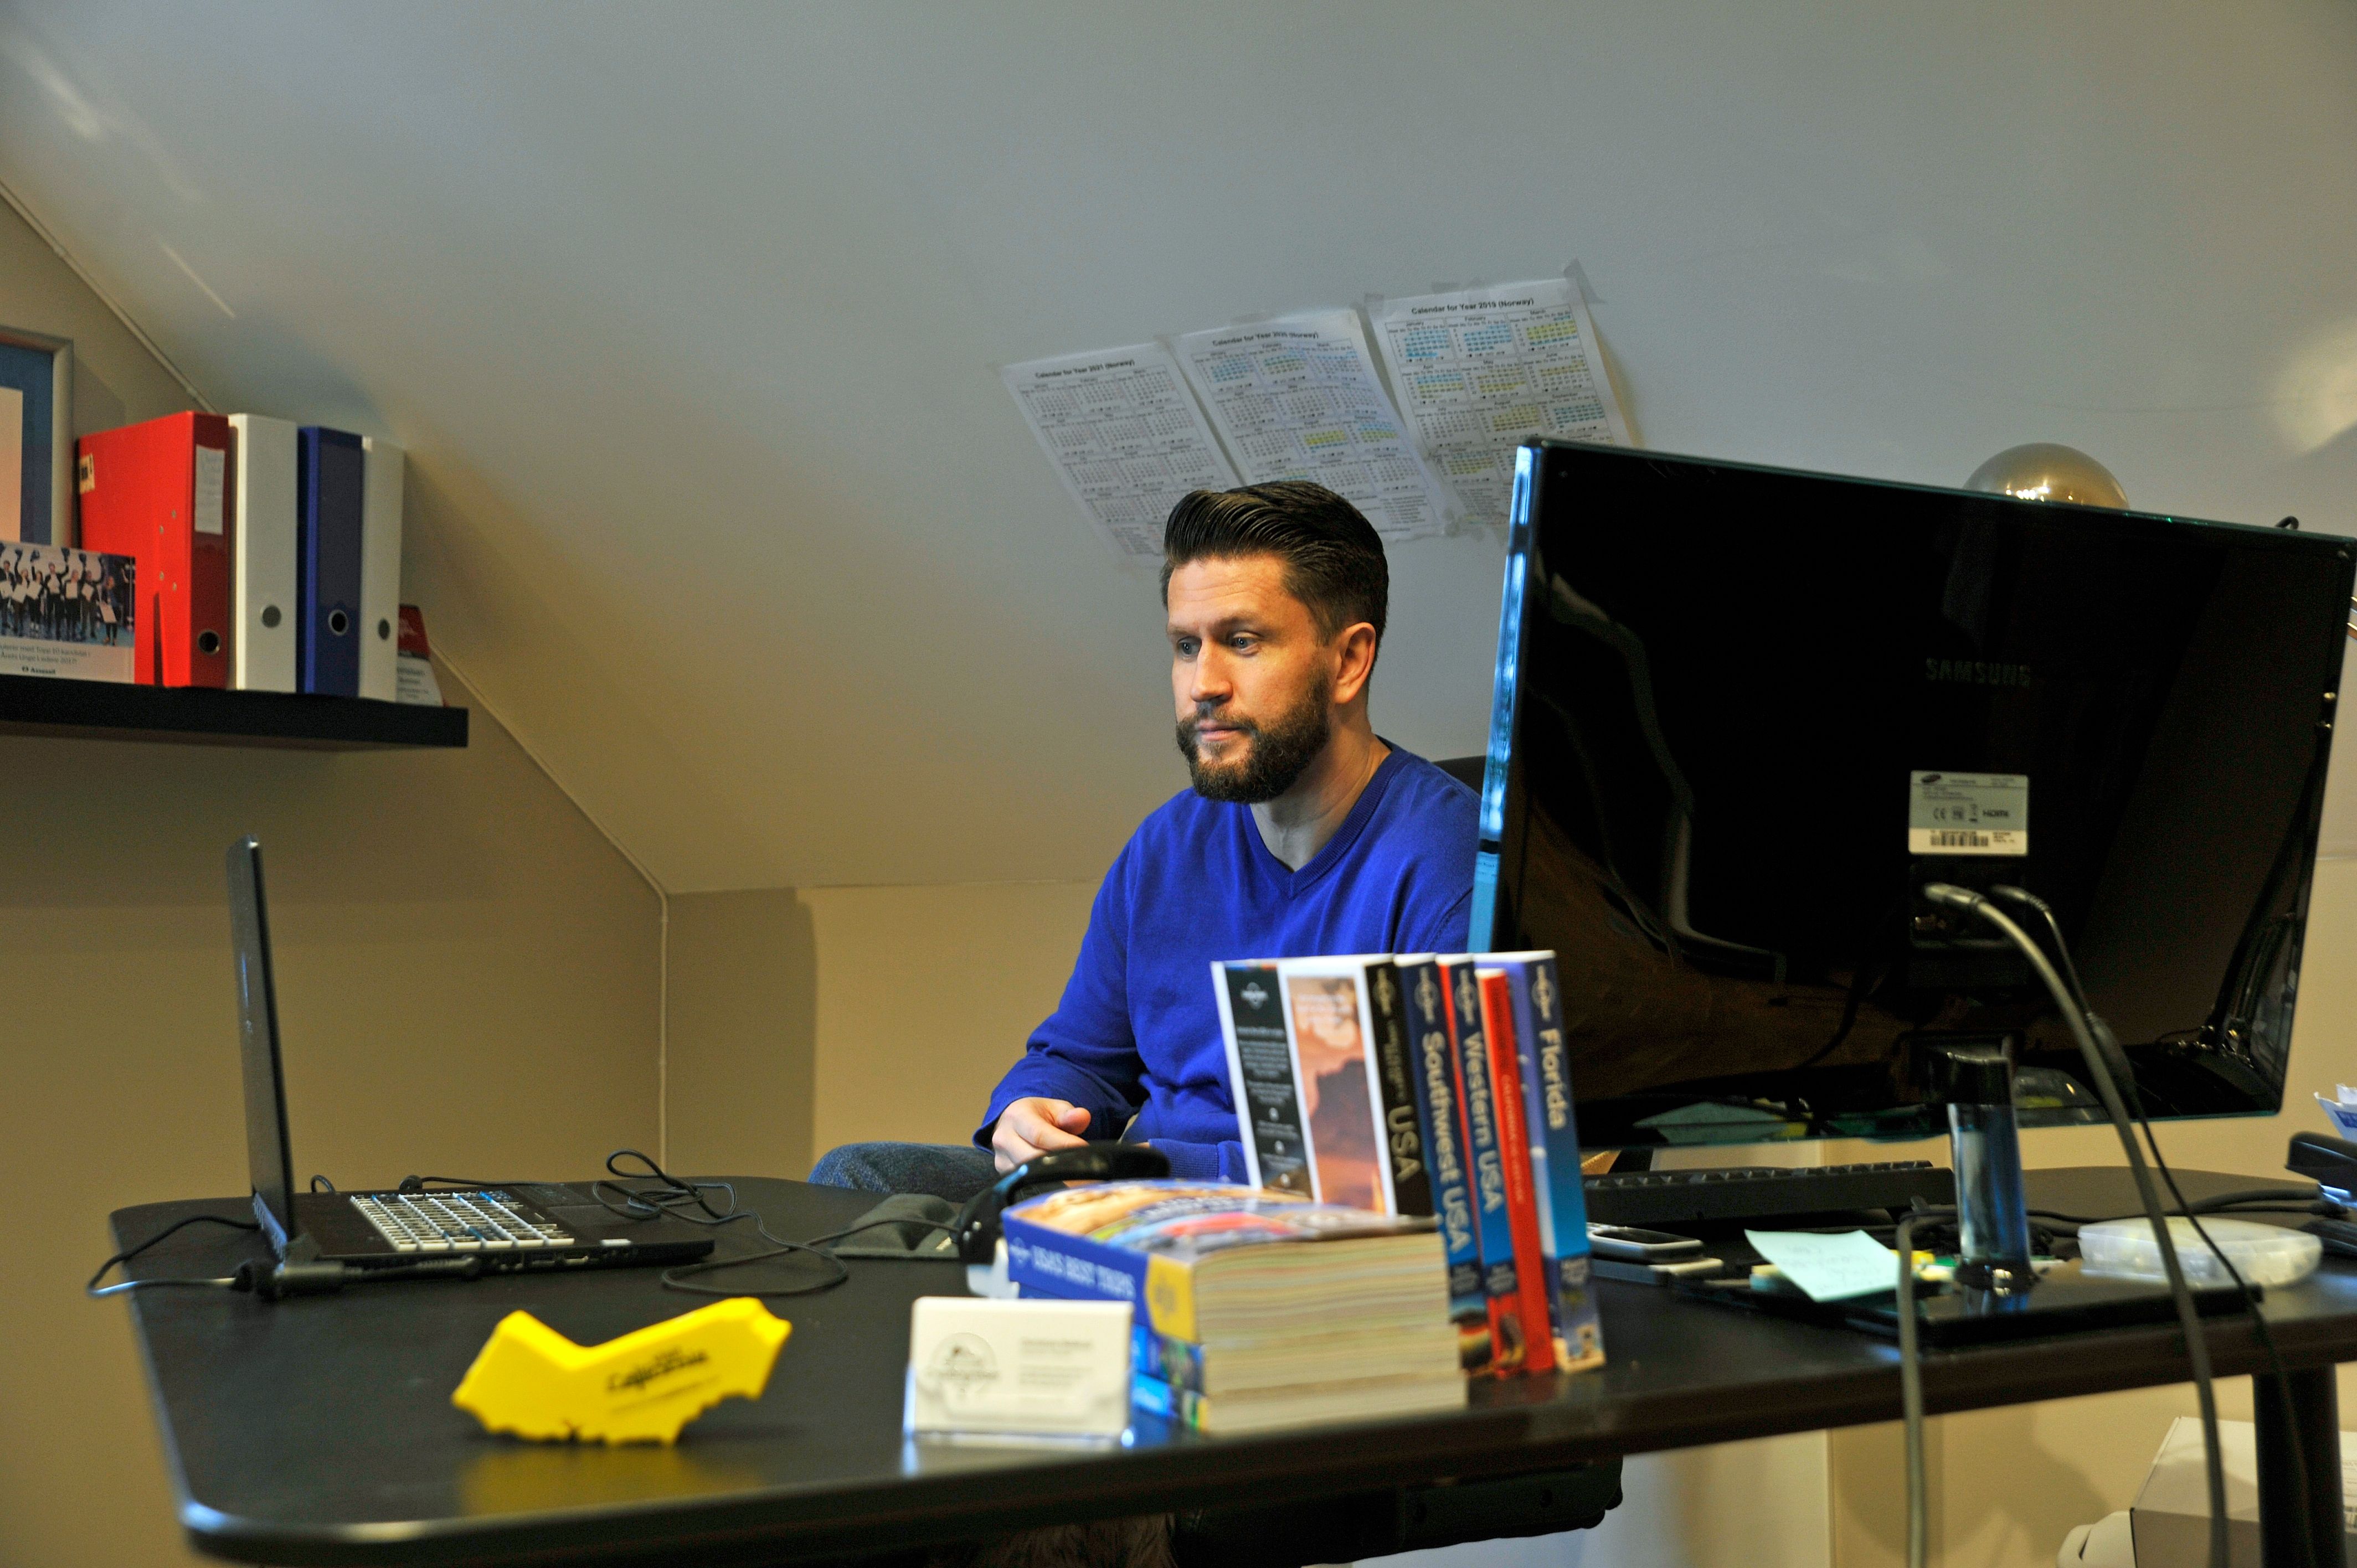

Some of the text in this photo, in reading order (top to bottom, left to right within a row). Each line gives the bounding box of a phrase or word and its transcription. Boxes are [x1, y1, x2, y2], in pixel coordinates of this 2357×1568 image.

[1412, 306, 1444, 314] Calendar
[1460, 302, 1478, 311] Year
[1498, 298, 1534, 308] (Norway)
[1926, 658, 2030, 687] SAMSUNG
[1464, 1031, 1493, 1147] Western
[1539, 1028, 1568, 1129] Florida
[1388, 1105, 1421, 1183] USA
[1422, 1031, 1462, 1184] Southwest
[1443, 1186, 1471, 1252] USA
[1478, 1150, 1504, 1213] USA
